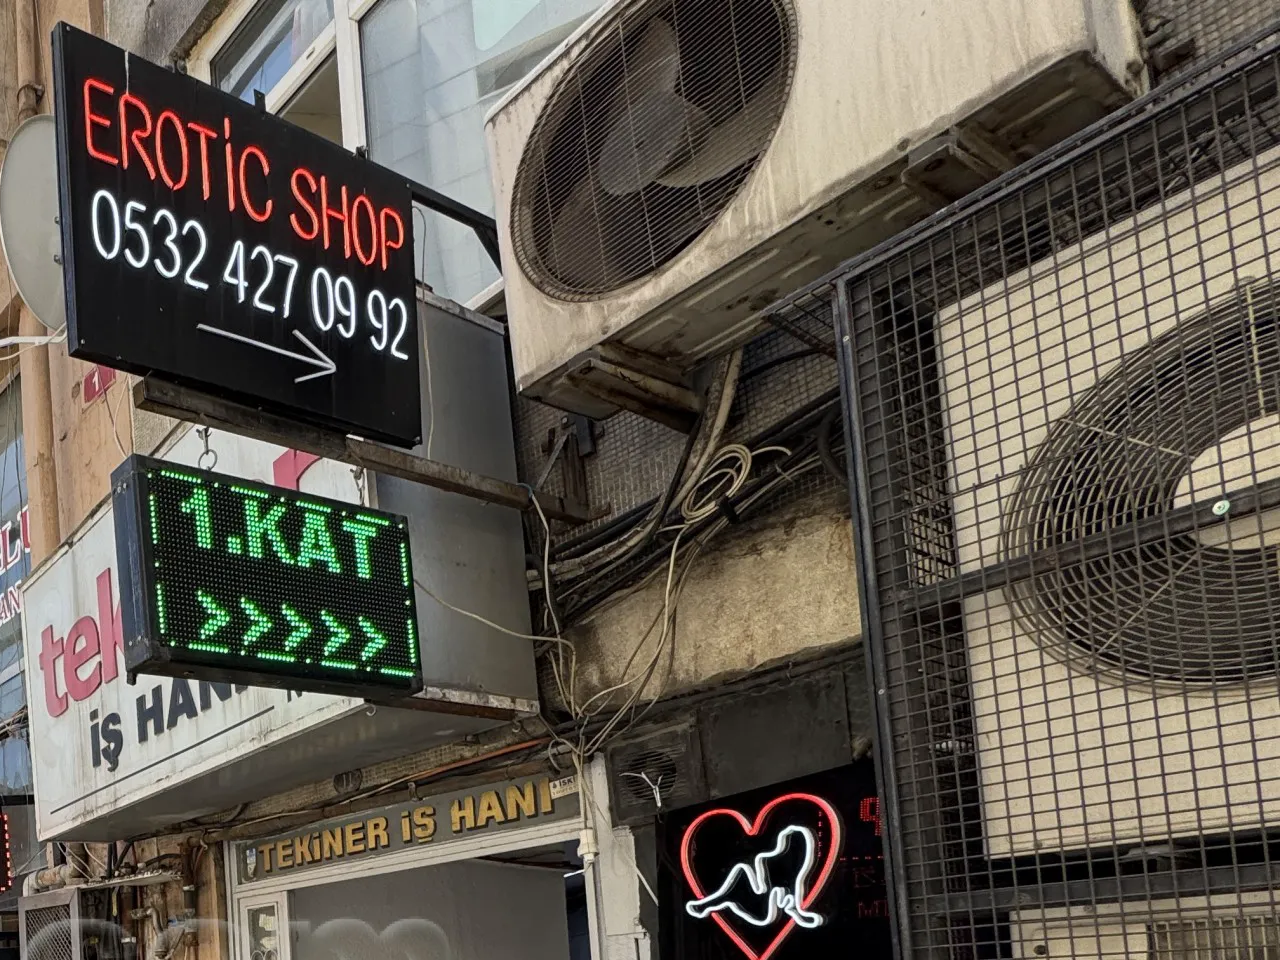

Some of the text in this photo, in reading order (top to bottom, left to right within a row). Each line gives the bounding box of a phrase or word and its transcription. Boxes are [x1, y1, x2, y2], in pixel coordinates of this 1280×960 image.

[289, 167, 404, 271] SHOP
[91, 189, 409, 361] 0532 427 09 92
[181, 486, 380, 580] 1.KAT
[451, 776, 555, 834] HANI
